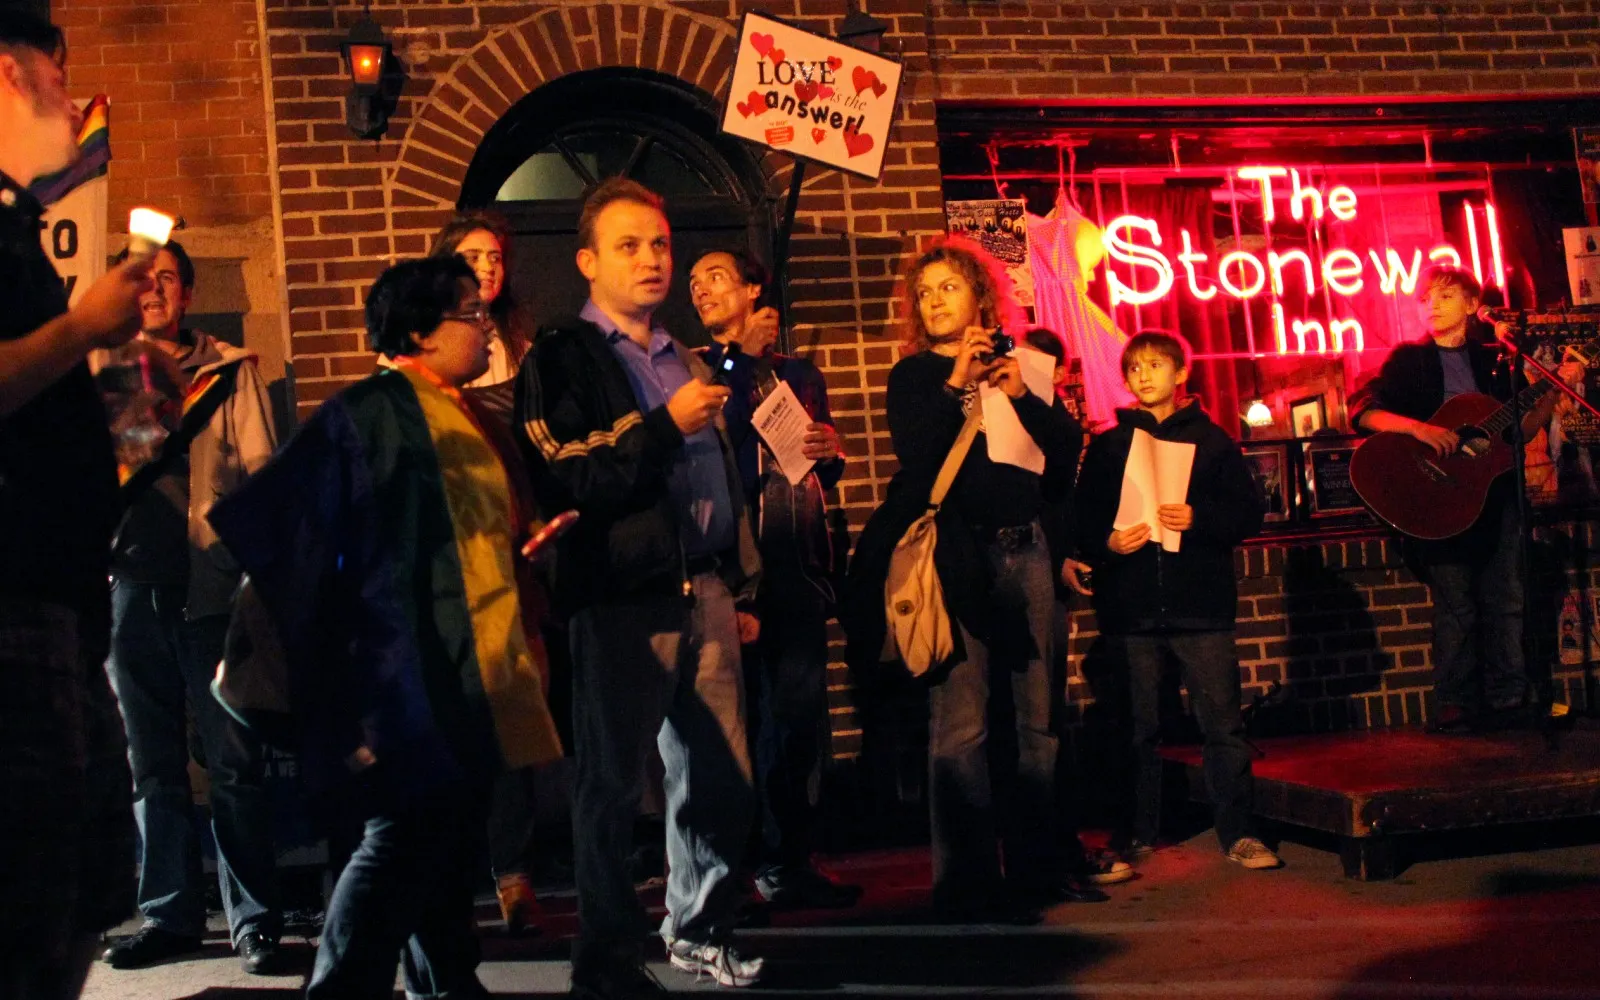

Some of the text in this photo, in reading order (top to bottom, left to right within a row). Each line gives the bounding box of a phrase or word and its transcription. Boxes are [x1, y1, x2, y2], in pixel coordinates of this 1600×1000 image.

[757, 61, 835, 85] LOVE
[764, 90, 865, 134] answer!
[829, 87, 868, 111] is the
[1238, 165, 1359, 222] The
[1273, 302, 1364, 354] Inn
